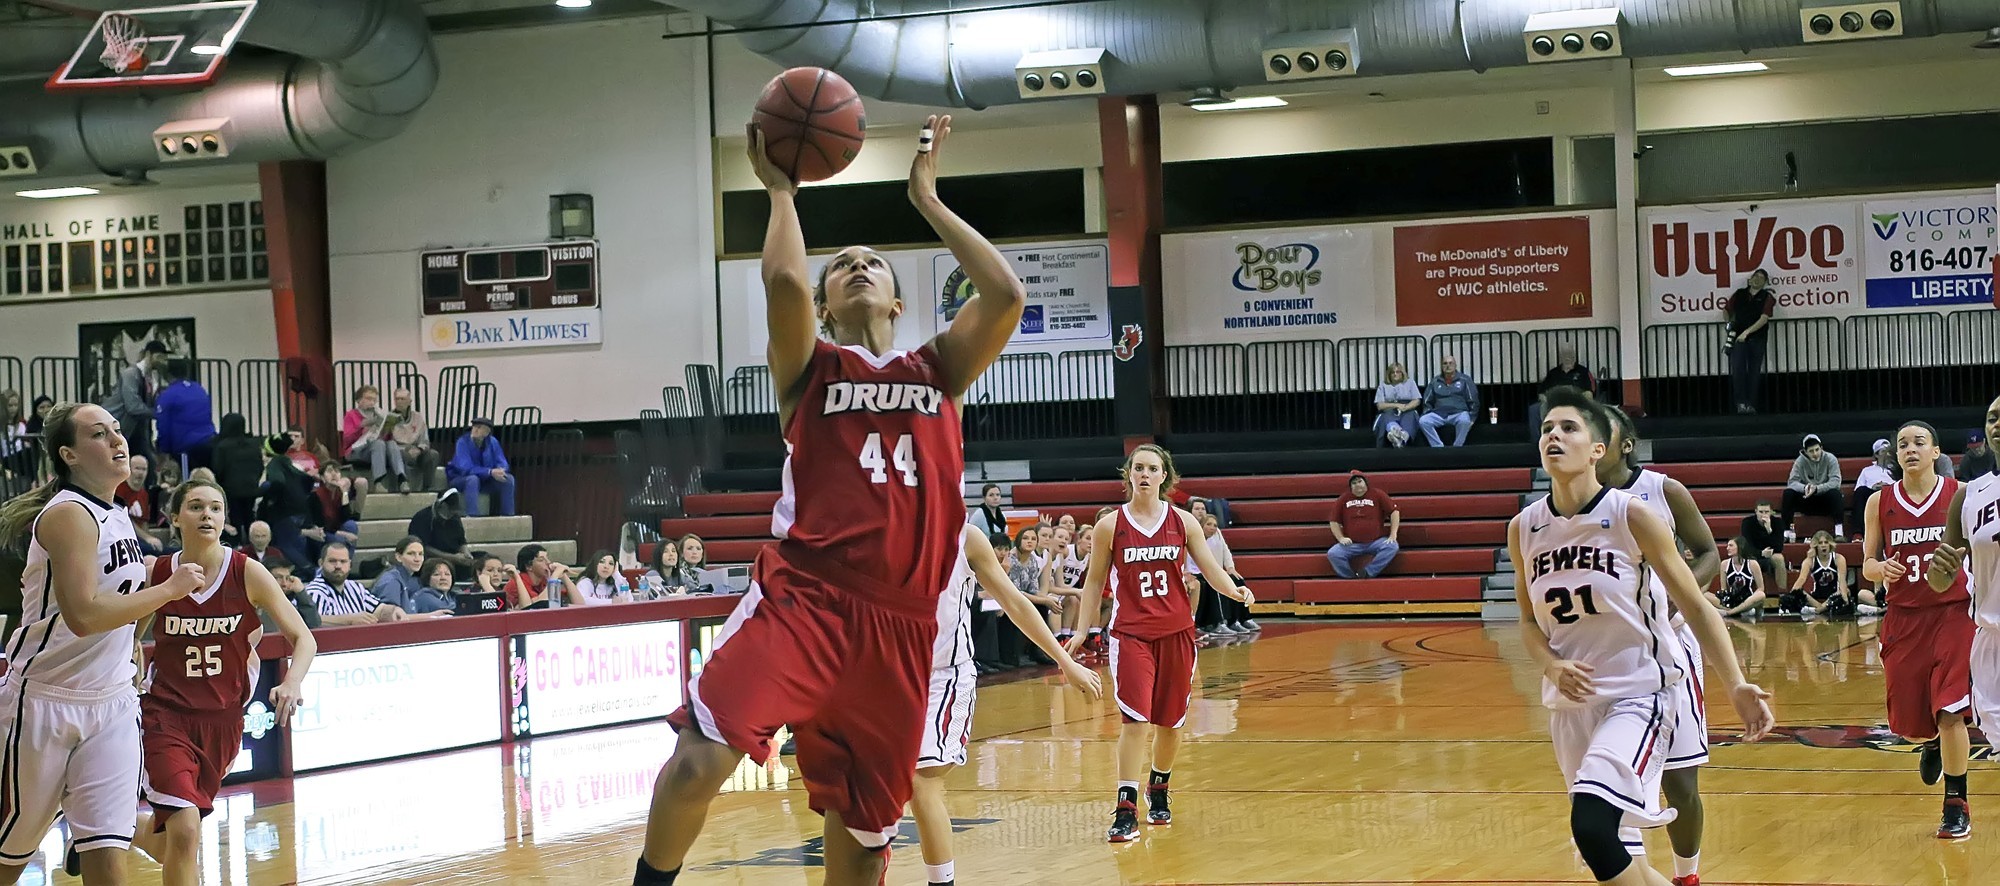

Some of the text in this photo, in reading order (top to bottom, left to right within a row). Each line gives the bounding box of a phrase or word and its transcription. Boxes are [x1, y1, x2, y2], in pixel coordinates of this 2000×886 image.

[4, 214, 160, 240] HALL OF FAME
[428, 255, 458, 268] HOME
[551, 246, 593, 261] VISITOR
[1025, 251, 1100, 263] FREE Hot Continental
[1235, 242, 1302, 279] Pour
[1415, 244, 1569, 263] The McDonald's of Liberty
[1042, 261, 1076, 270] Breakfast
[1425, 262, 1560, 279] are Proud Supporters
[1026, 276, 1041, 284] FREE
[1253, 265, 1322, 295] Boys
[1437, 280, 1548, 297] of WJC athletics.
[1747, 273, 1839, 287] ELOYEE OWNED
[487, 292, 515, 303] PERIOD
[551, 294, 578, 305] BONUS
[1026, 288, 1075, 299] Kids stay FREE
[1661, 291, 1729, 313] Stude
[440, 301, 466, 312] BONUS
[1244, 298, 1314, 312] 9 CONVENIENT
[1224, 312, 1337, 329] NORTHLAND LOCATIONS
[455, 317, 590, 345] BANK MIDWEST
[822, 381, 943, 417] DRURY
[859, 432, 918, 487] 44
[1972, 497, 2000, 535] JE
[1123, 546, 1180, 564] DRURY
[1531, 546, 1620, 585] JEWELL
[1139, 569, 1169, 598] 23
[1545, 584, 1600, 624] 21
[164, 614, 243, 637] DRURY
[185, 645, 222, 678] 25
[535, 640, 676, 691] GO CARDINALS
[334, 663, 415, 688] HONDA
